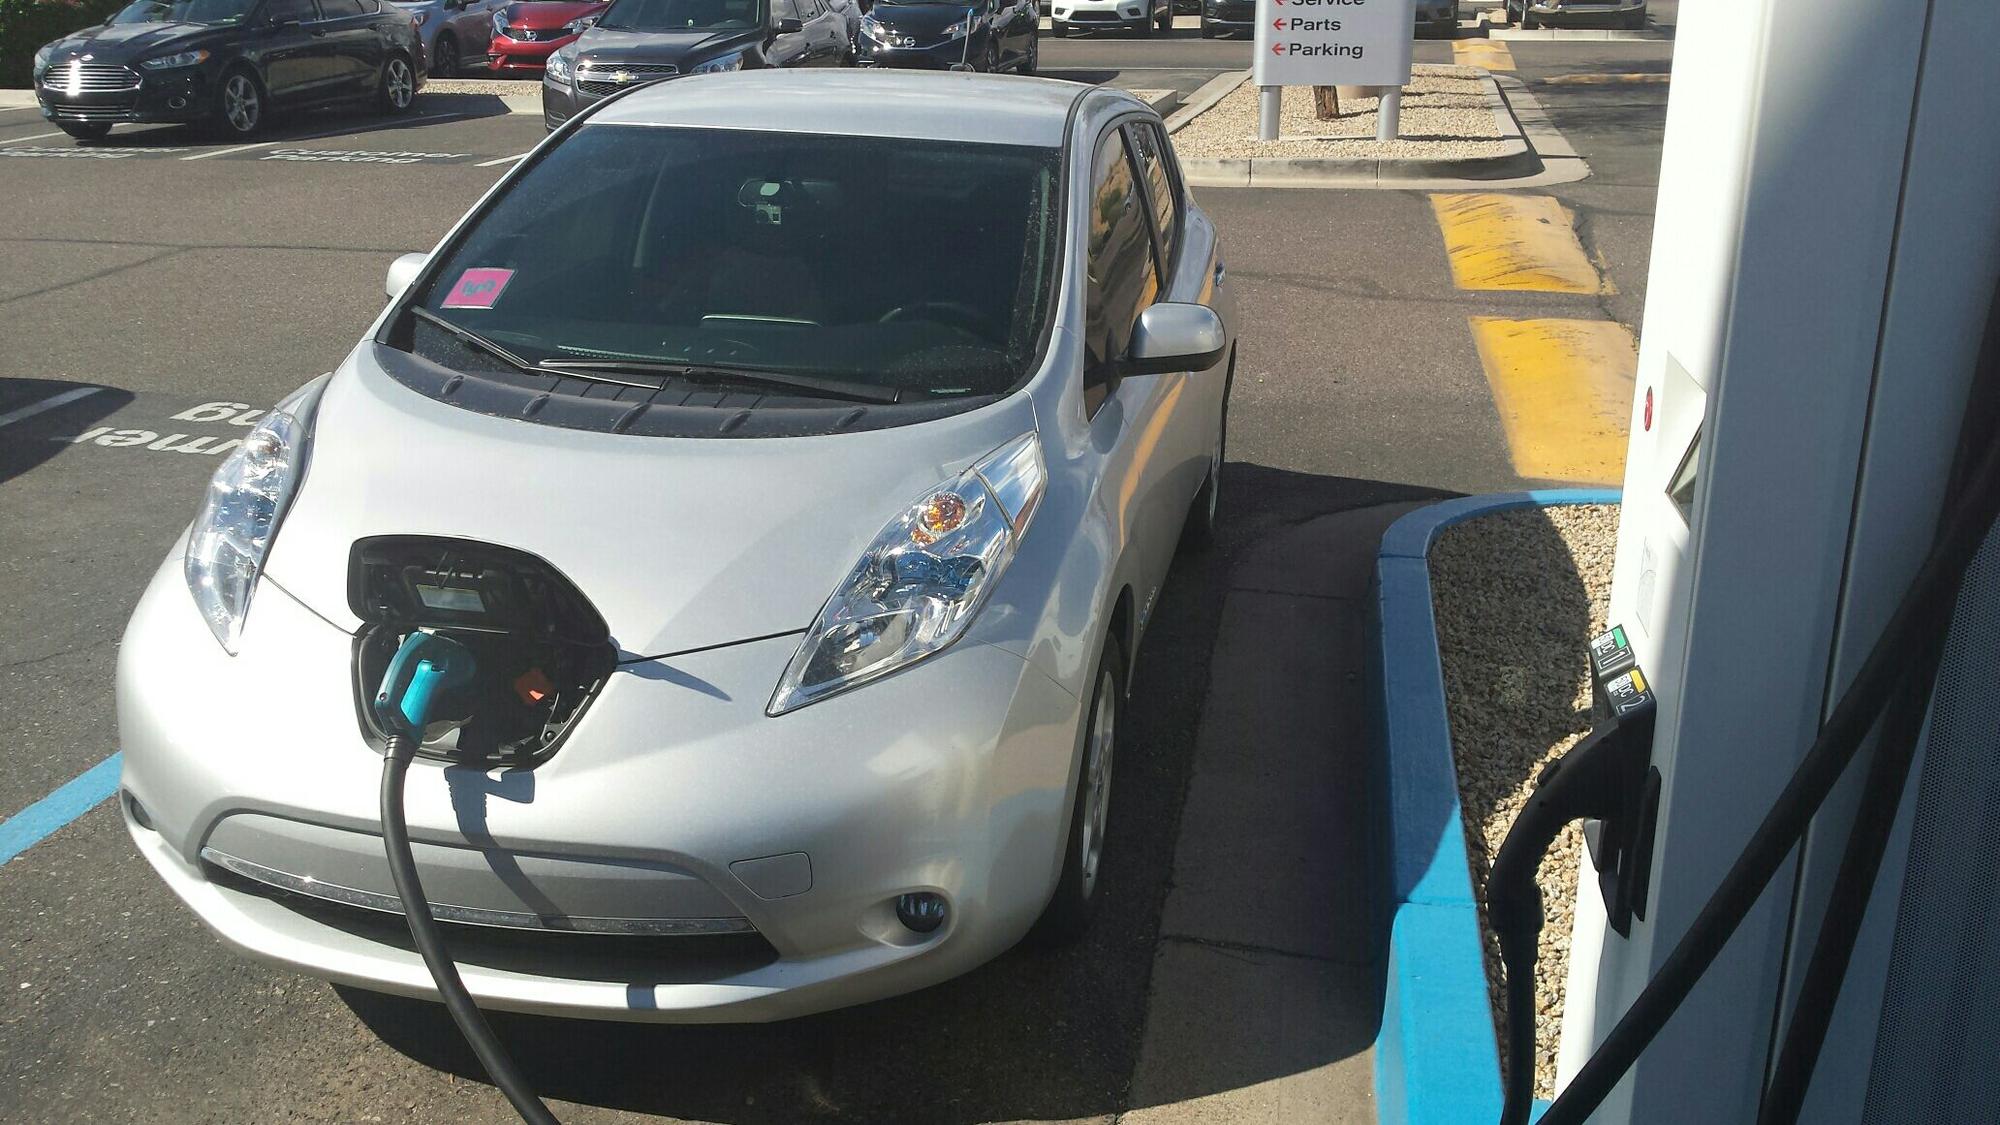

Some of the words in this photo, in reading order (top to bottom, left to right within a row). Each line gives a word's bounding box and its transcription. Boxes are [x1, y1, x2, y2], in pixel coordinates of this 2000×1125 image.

[1290, 18, 1342, 31] Parts
[1289, 43, 1364, 60] Parking
[259, 154, 423, 164] Parking
[1602, 651, 1626, 666] 1
[1620, 695, 1646, 712] 2
